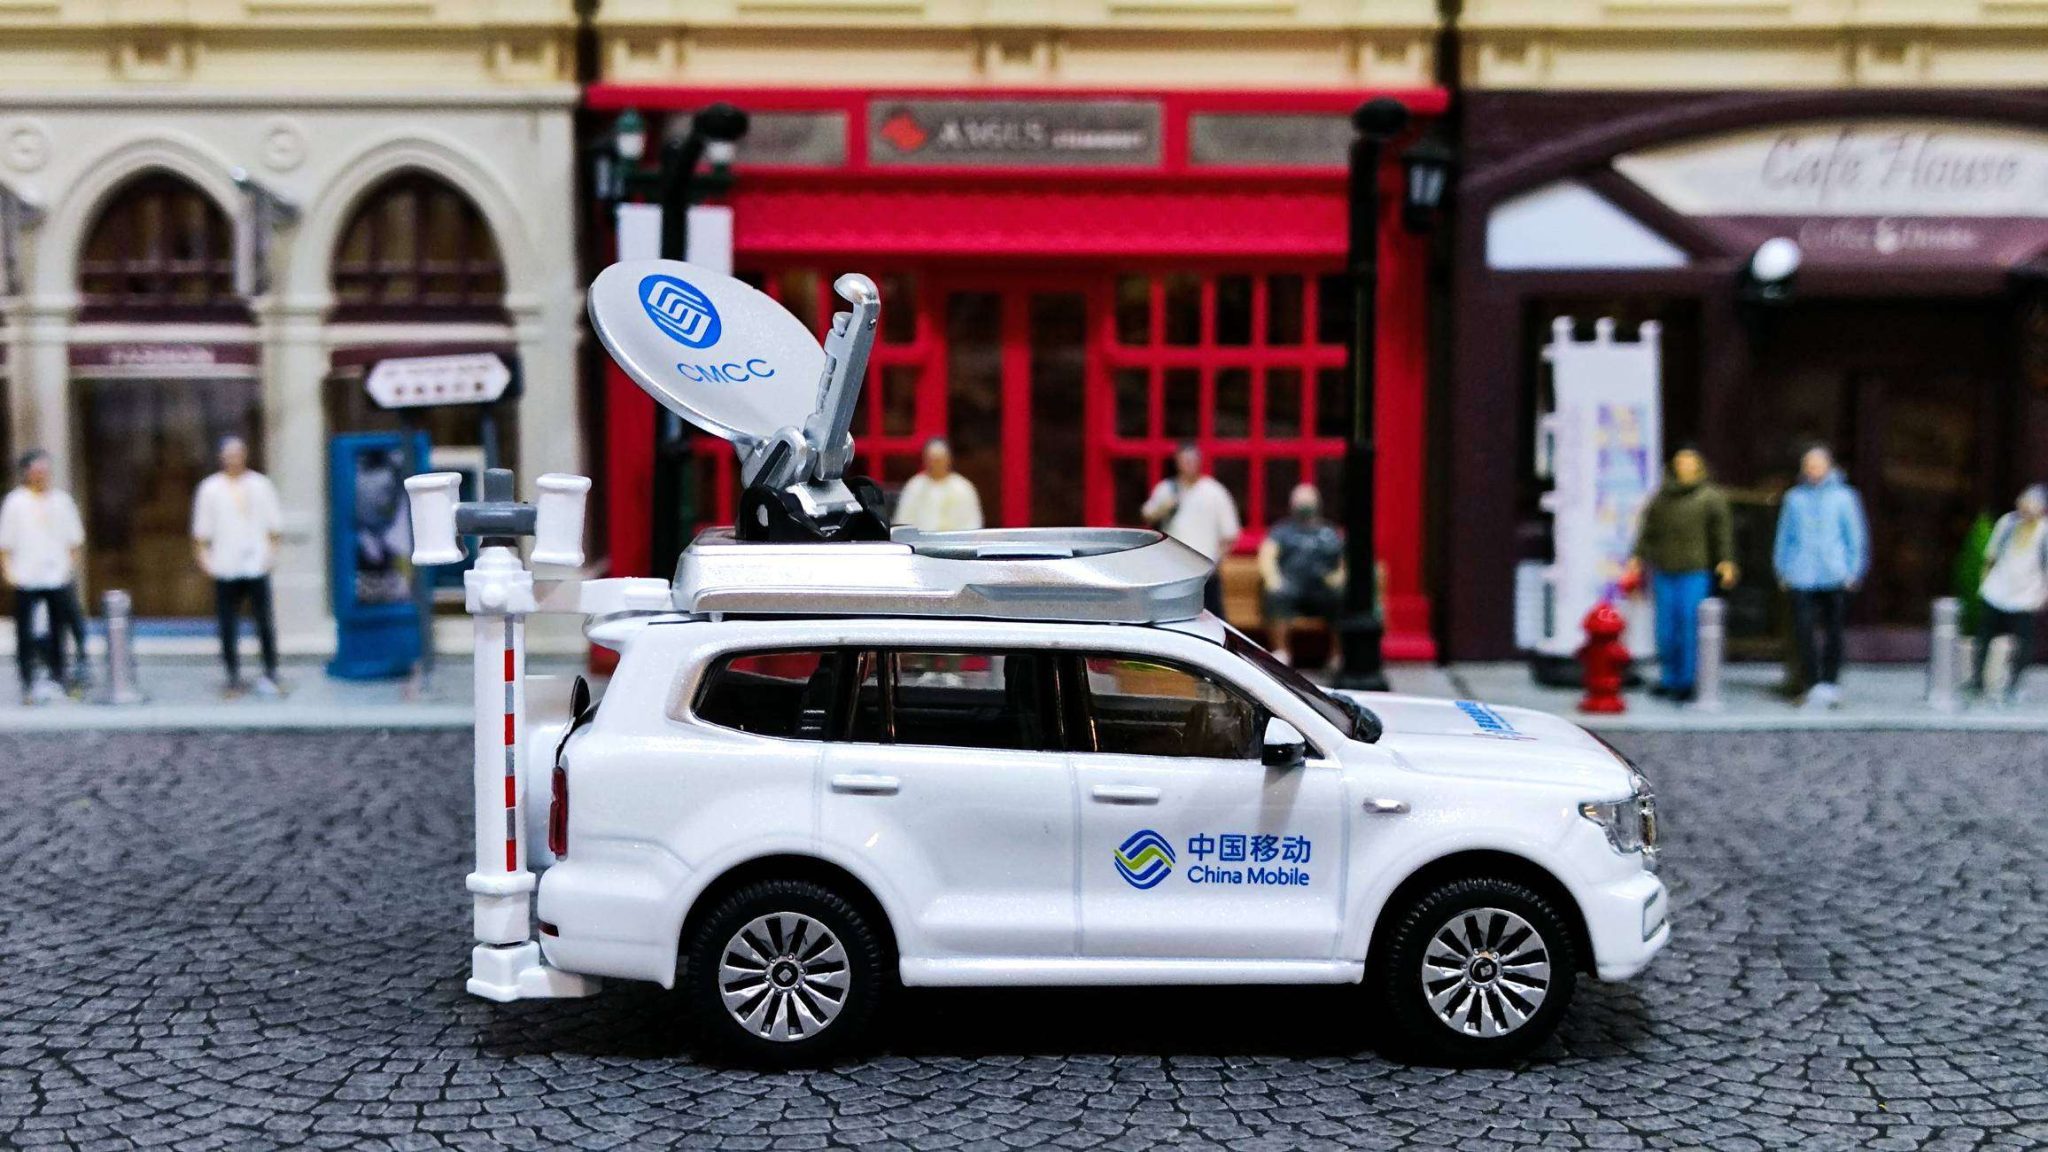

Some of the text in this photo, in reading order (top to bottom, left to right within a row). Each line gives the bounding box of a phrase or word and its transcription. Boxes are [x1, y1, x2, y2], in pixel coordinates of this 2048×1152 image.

[676, 358, 775, 384] CMCC
[1188, 833, 1311, 864] 中国移动
[1187, 865, 1310, 886] China Mobile
